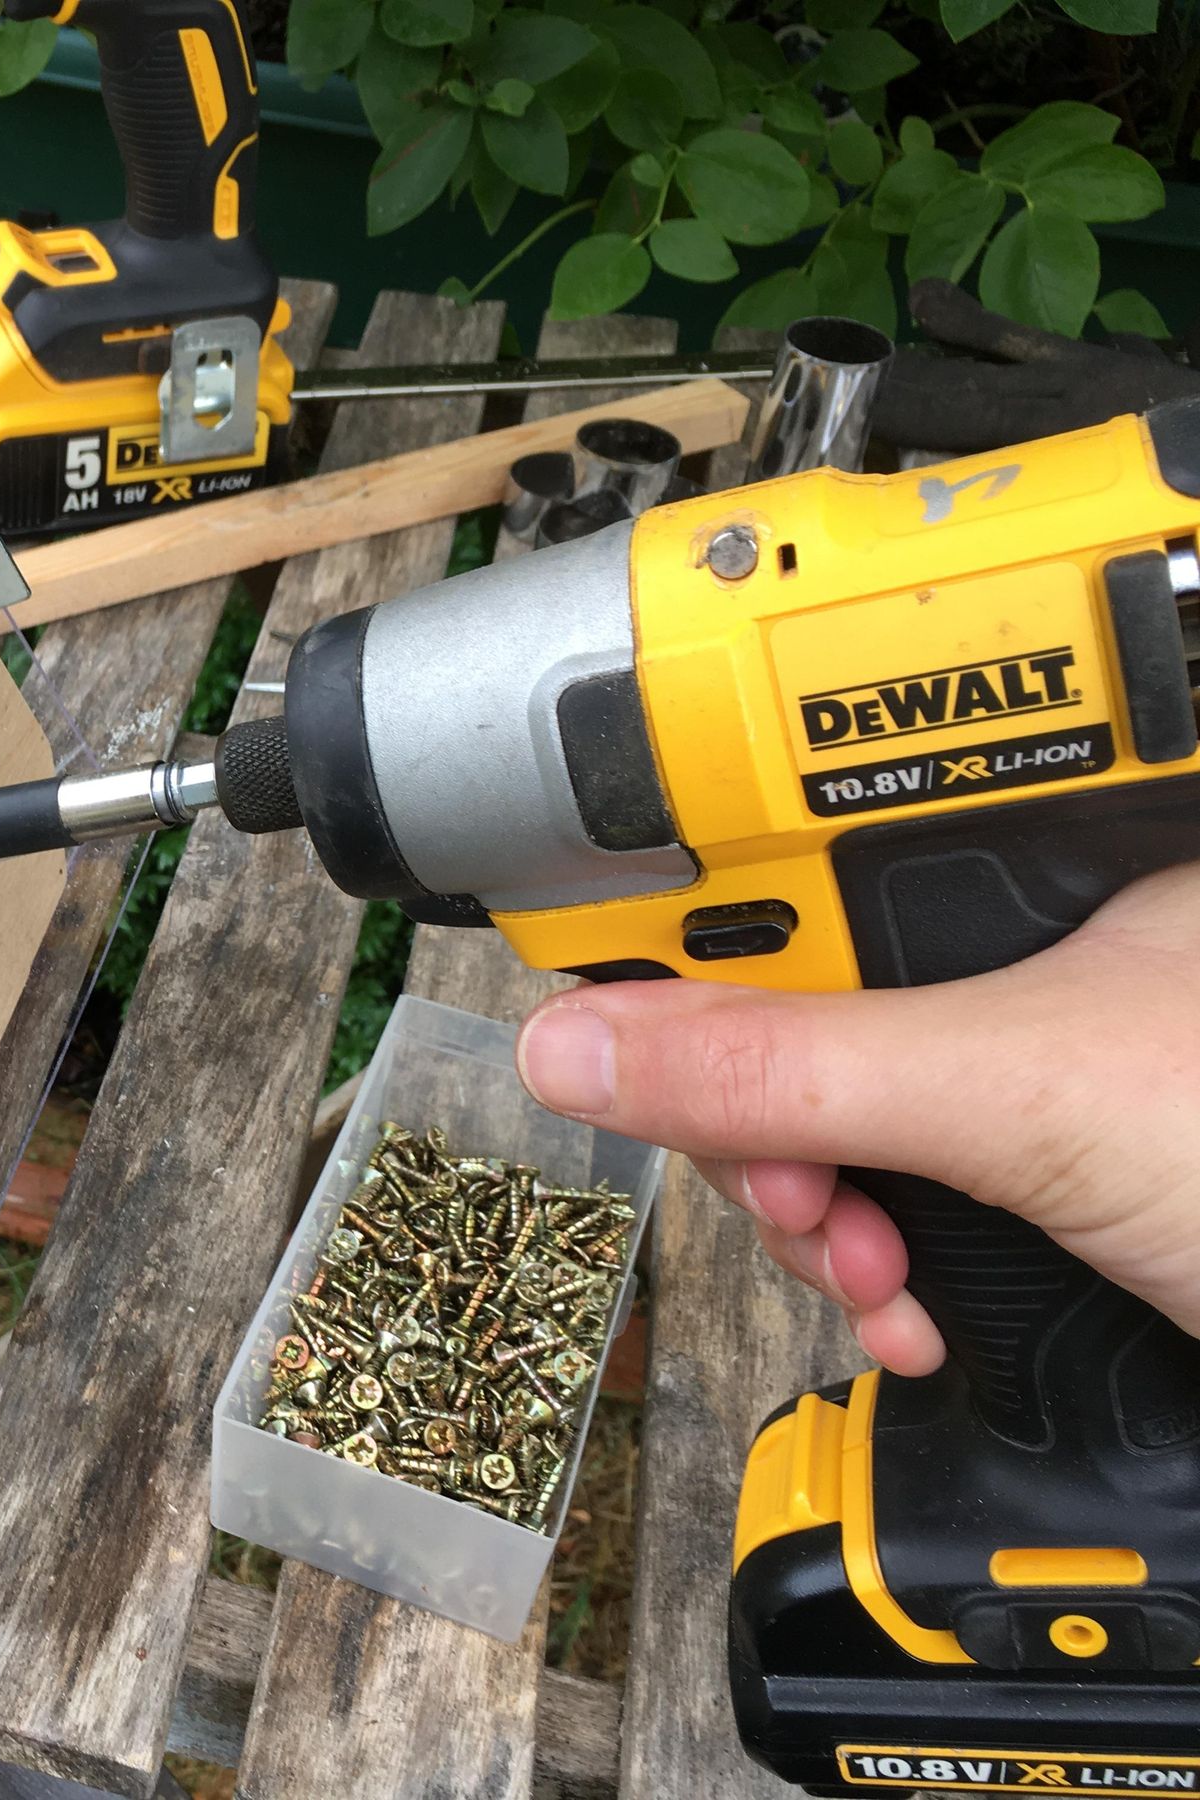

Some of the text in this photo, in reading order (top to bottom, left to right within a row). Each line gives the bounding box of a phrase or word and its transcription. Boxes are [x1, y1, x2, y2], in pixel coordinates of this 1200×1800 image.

[64, 436, 102, 490] 5
[62, 489, 100, 513] AH
[113, 474, 253, 506] 18V XR LI-ION
[940, 756, 995, 785] XR
[994, 741, 1093, 772] LI-ION
[1015, 1762, 1072, 1786] XR
[1080, 1766, 1196, 1789] LI-ION
